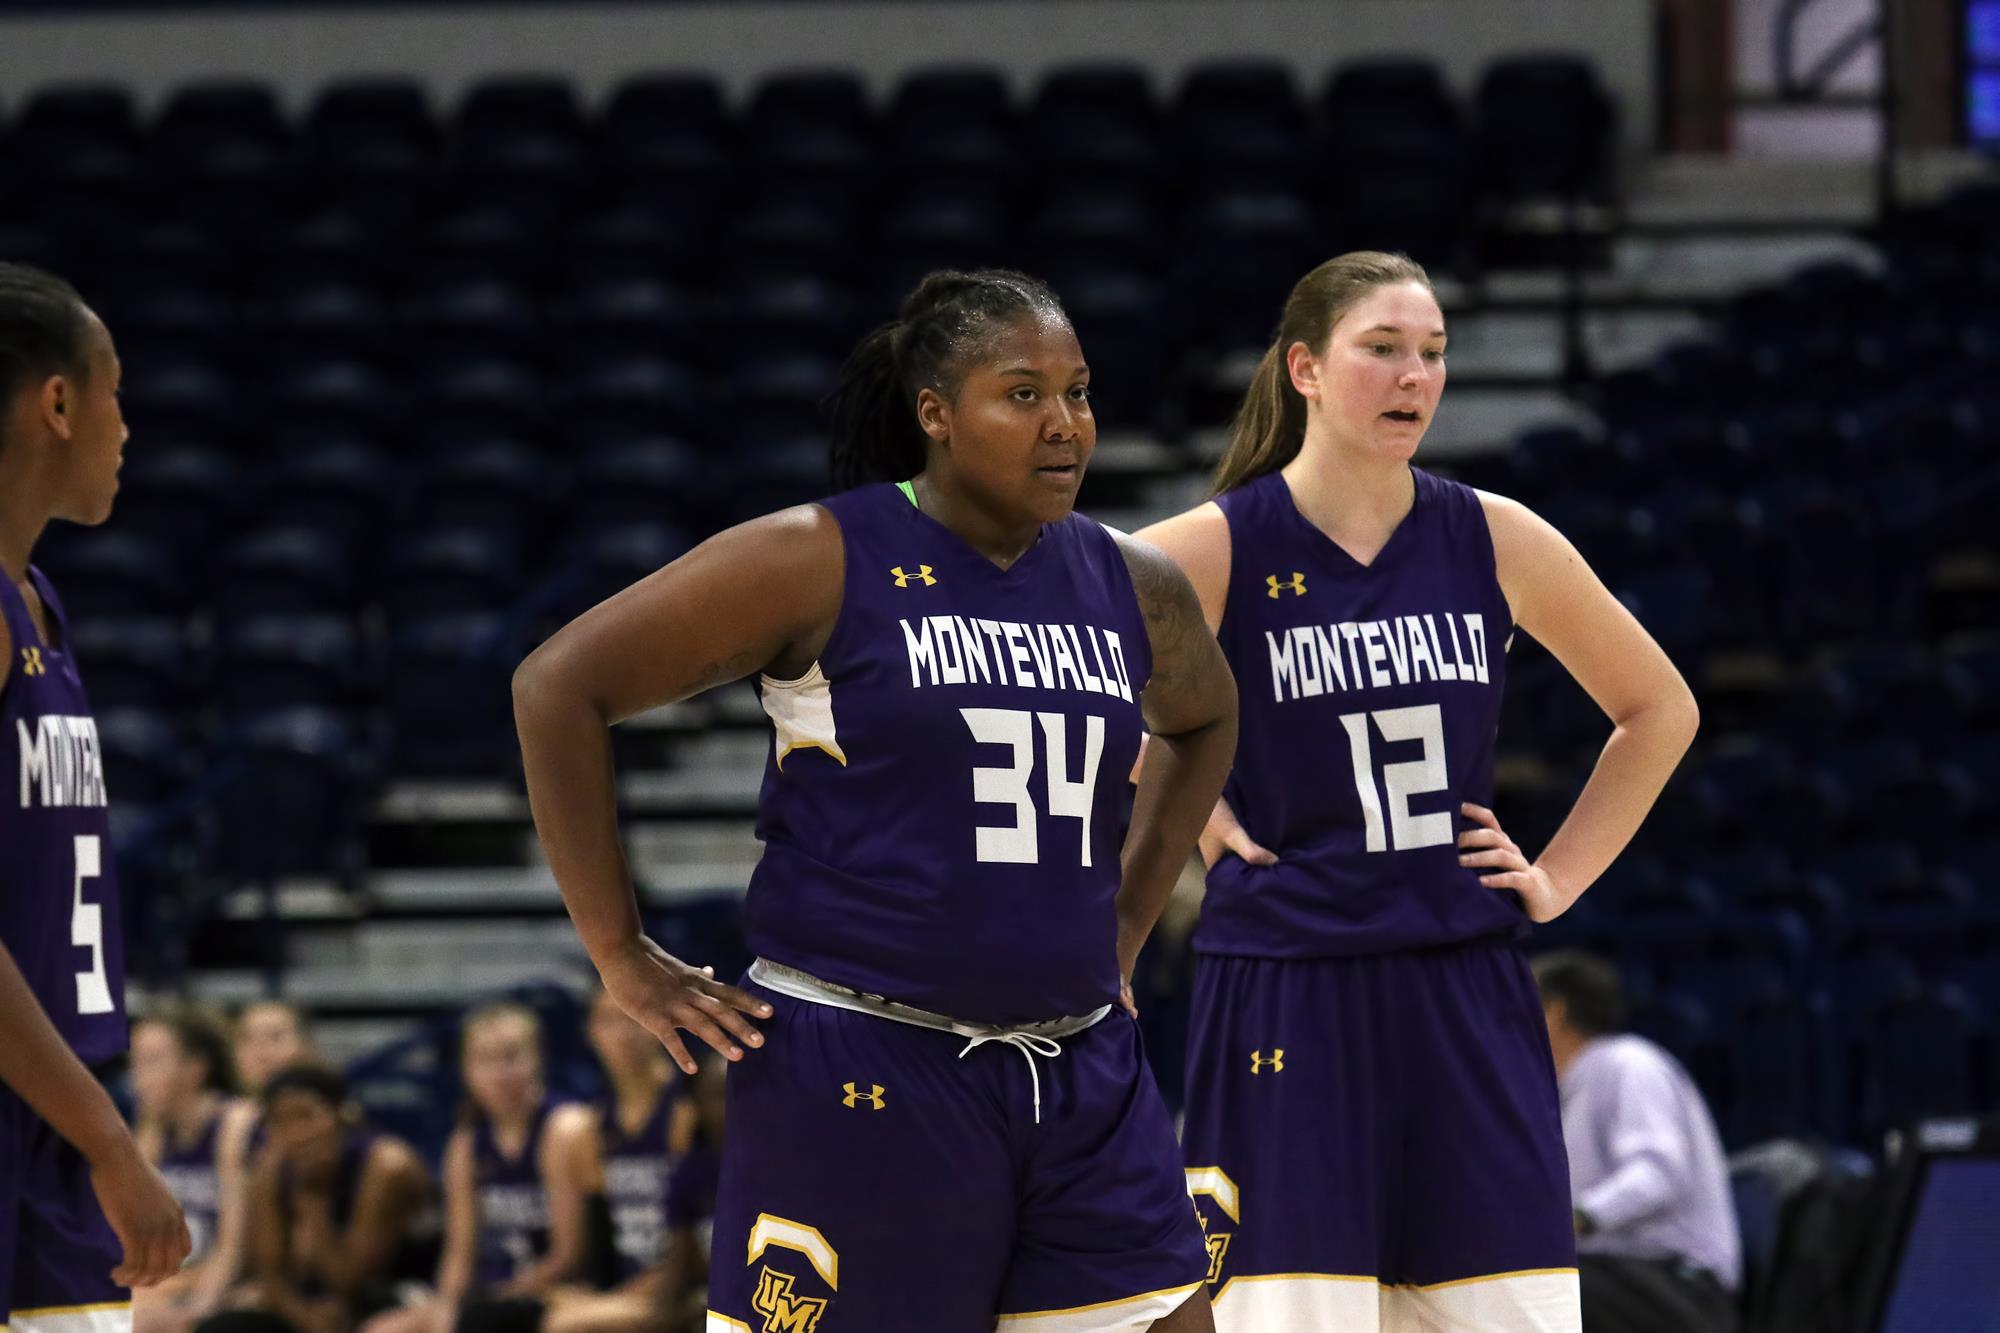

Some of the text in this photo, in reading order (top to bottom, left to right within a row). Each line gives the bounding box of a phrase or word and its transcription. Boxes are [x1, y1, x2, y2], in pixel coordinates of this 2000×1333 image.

[899, 615, 1134, 704] MONTEVALLO
[1265, 612, 1490, 703] MONTEVALLO
[958, 707, 1106, 868] 34
[1338, 703, 1454, 853] 12
[71, 834, 115, 1015] 5
